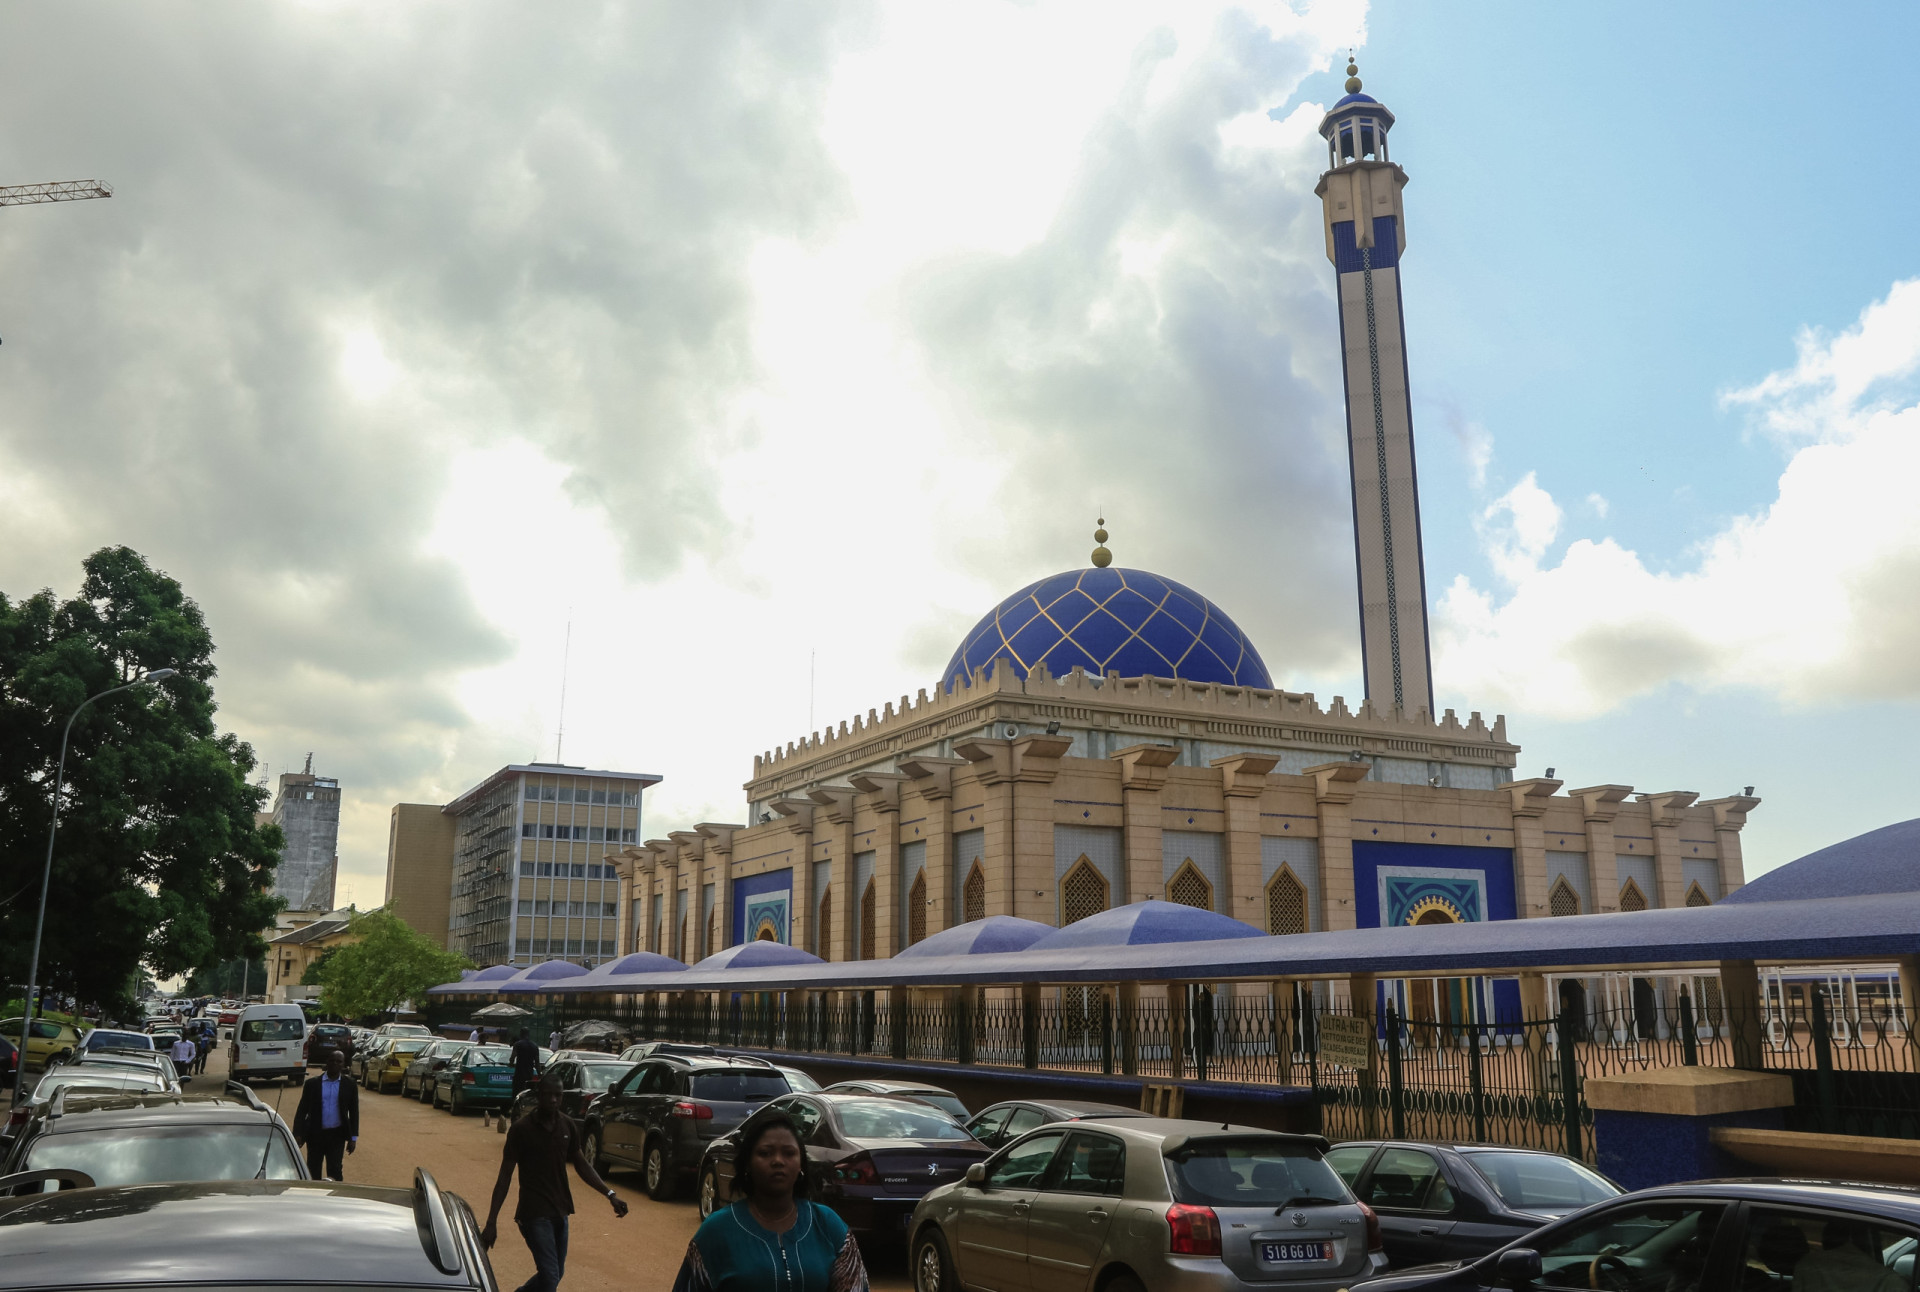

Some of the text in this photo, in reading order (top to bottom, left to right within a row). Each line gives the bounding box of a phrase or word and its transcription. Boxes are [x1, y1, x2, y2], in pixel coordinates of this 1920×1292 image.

[1323, 1017, 1364, 1034] ULTRA-NET
[1322, 1032, 1366, 1045] NETTOYAGE DES
[1266, 1244, 1319, 1259] 518 GG 01
